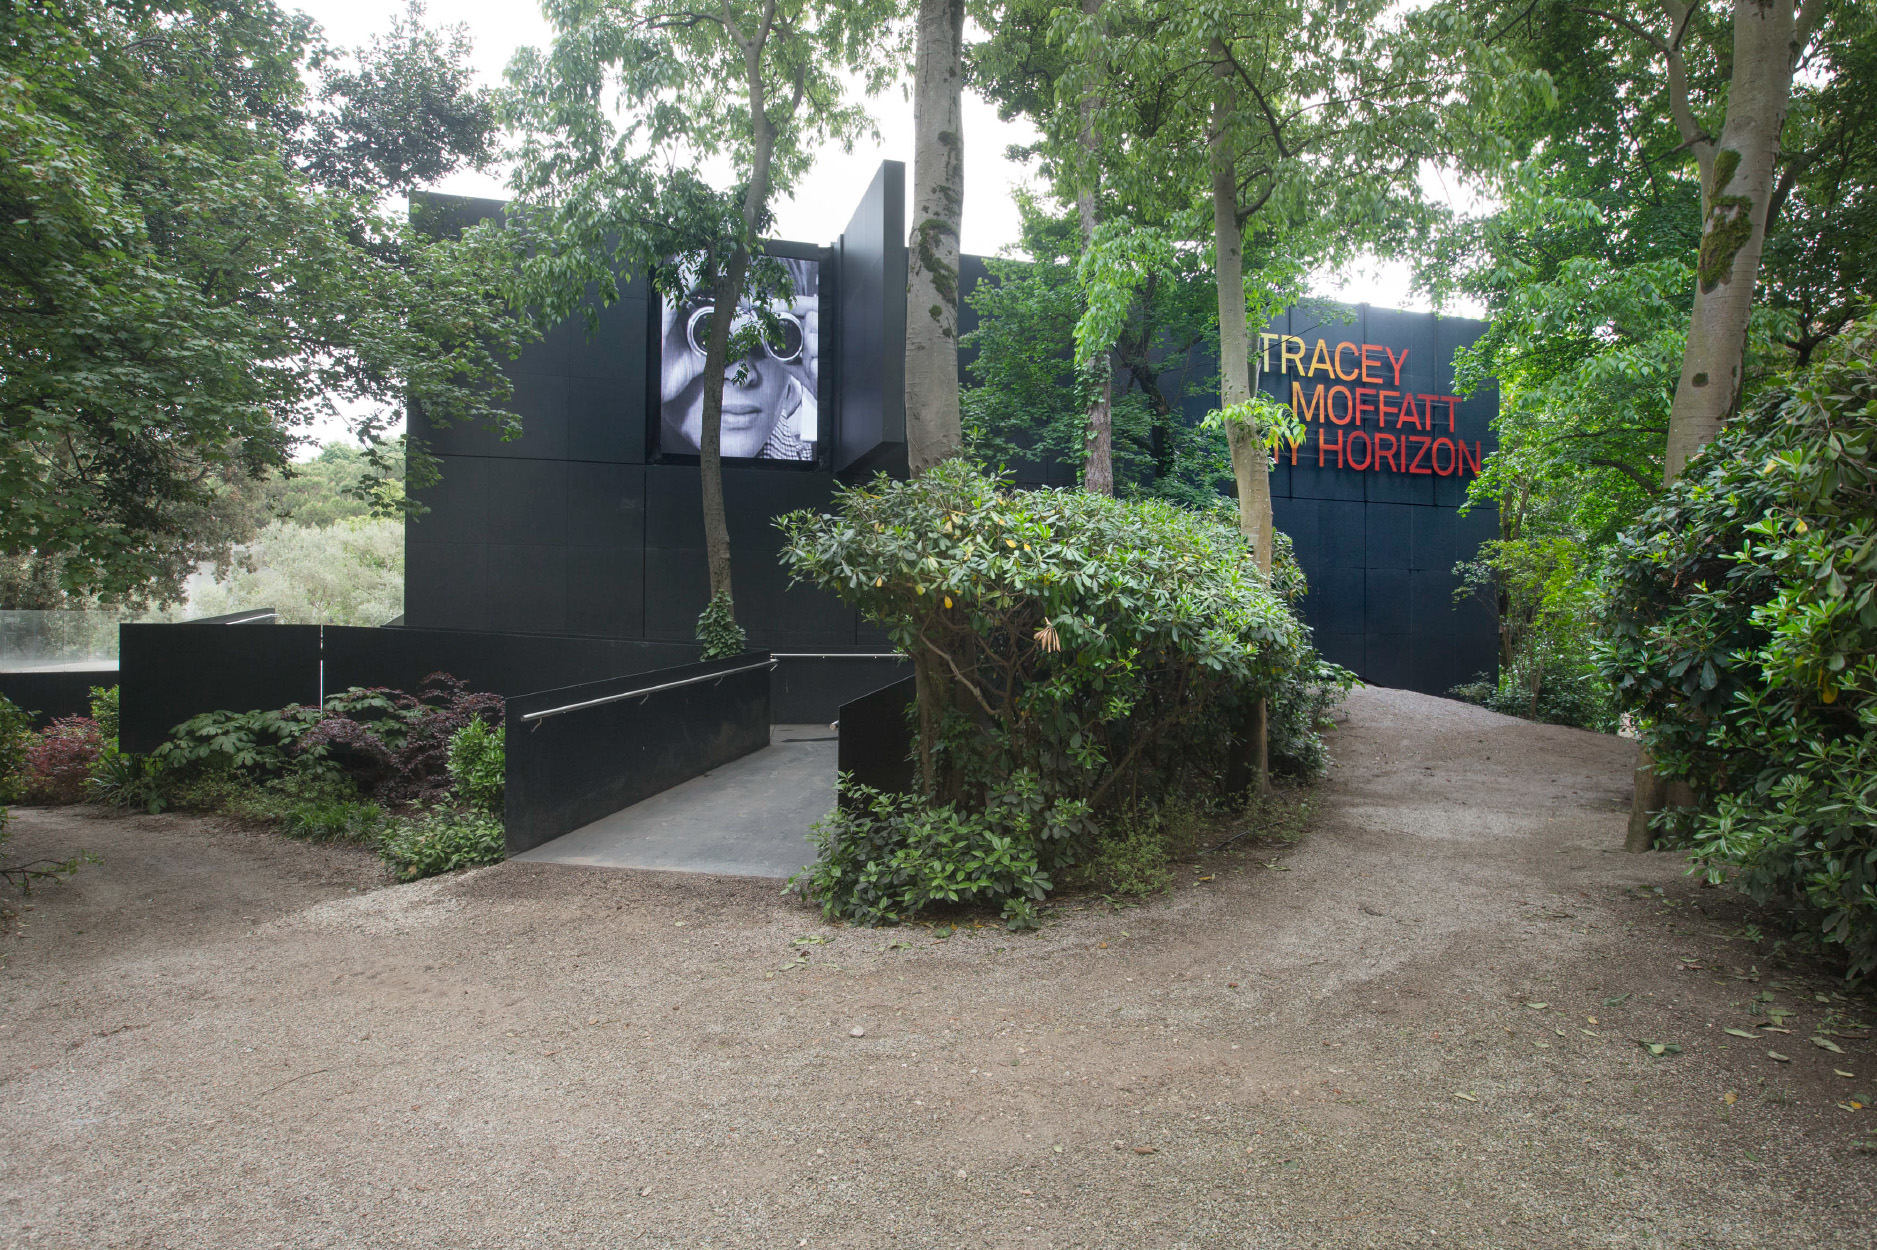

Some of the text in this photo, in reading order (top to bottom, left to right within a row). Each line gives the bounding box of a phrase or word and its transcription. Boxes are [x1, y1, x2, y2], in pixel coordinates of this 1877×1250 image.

[1259, 333, 1409, 385] TRACEY
[1292, 381, 1462, 432] MOFFATT
[1319, 428, 1481, 477] HORIZON
